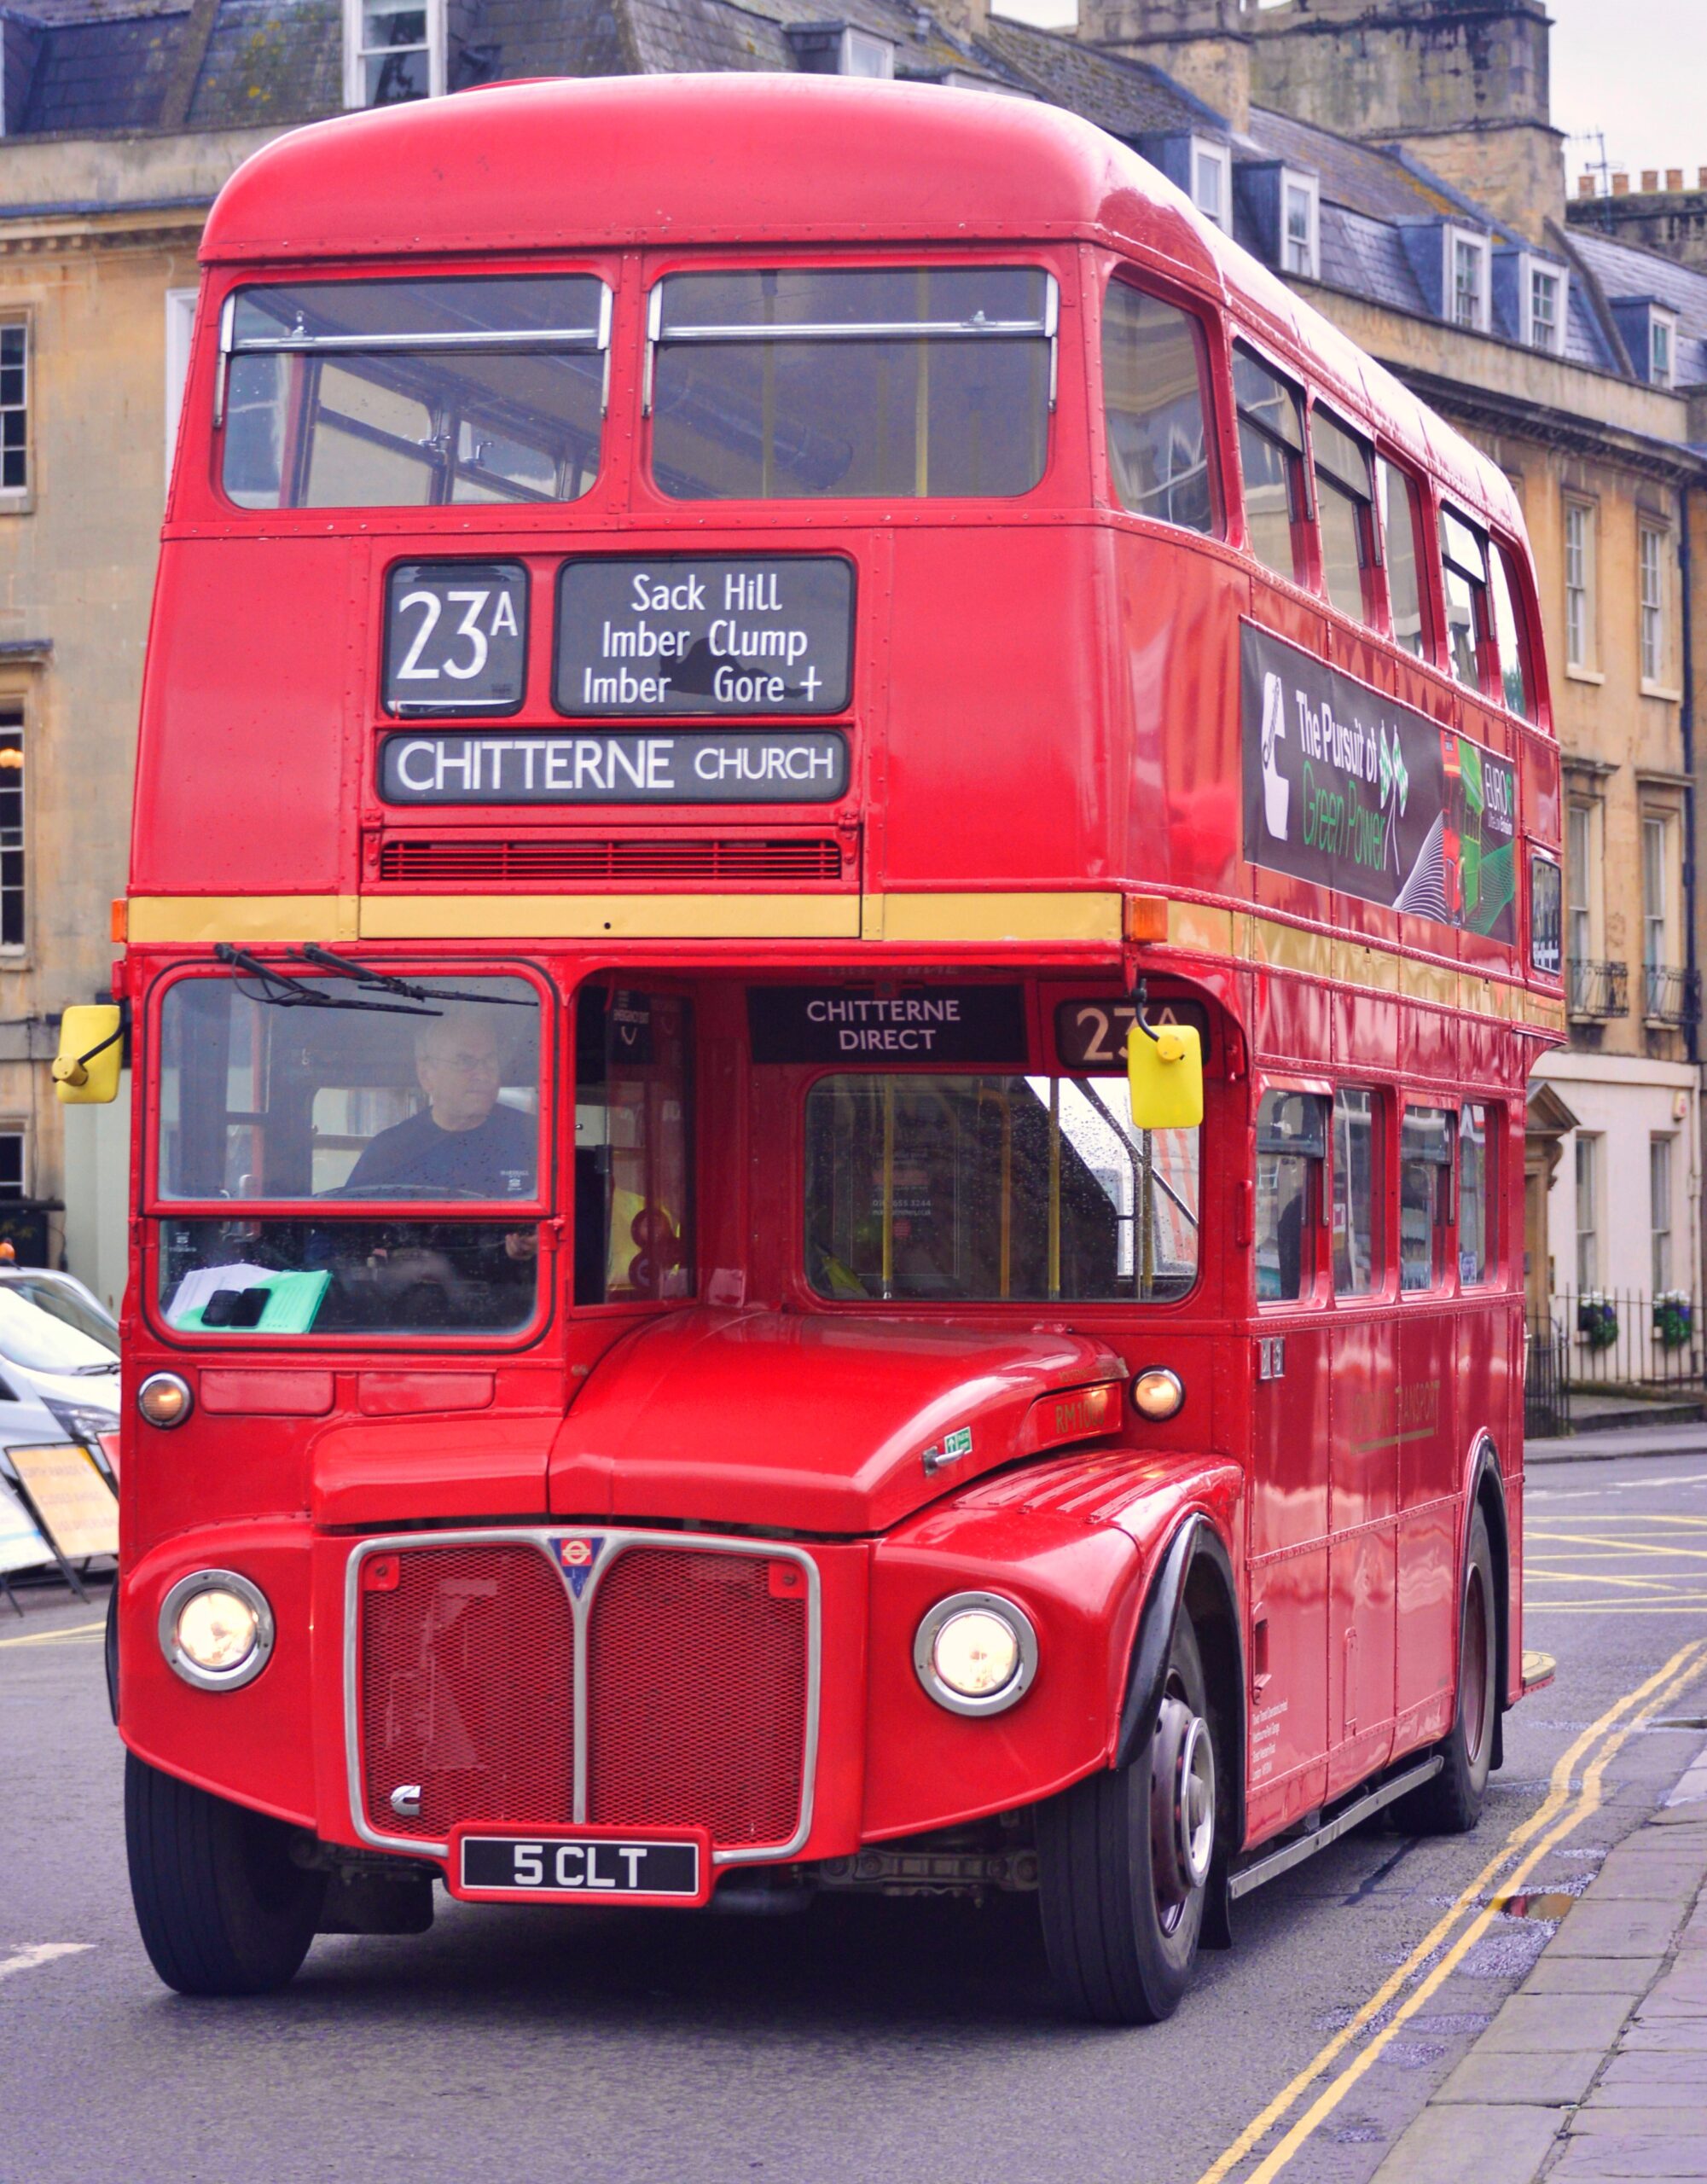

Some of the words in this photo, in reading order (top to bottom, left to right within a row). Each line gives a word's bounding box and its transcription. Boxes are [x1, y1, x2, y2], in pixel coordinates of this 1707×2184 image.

[632, 573, 705, 612] Sack
[725, 573, 782, 612] Hill
[602, 621, 690, 658] Imber
[709, 620, 808, 666] Clump
[584, 668, 671, 703] Imber
[714, 666, 785, 703] Gore
[1296, 689, 1321, 759] The
[1321, 702, 1364, 778] Pursuit
[1366, 727, 1378, 783] of
[397, 740, 675, 790] CHITTERNE
[694, 747, 833, 780] CHURCH
[1303, 759, 1345, 857] Green
[1345, 780, 1385, 870] Power
[806, 1000, 961, 1022] CHITTERNE
[839, 1029, 937, 1050] DIRECT
[514, 1844, 543, 1885] 5
[555, 1846, 648, 1888] CLT
